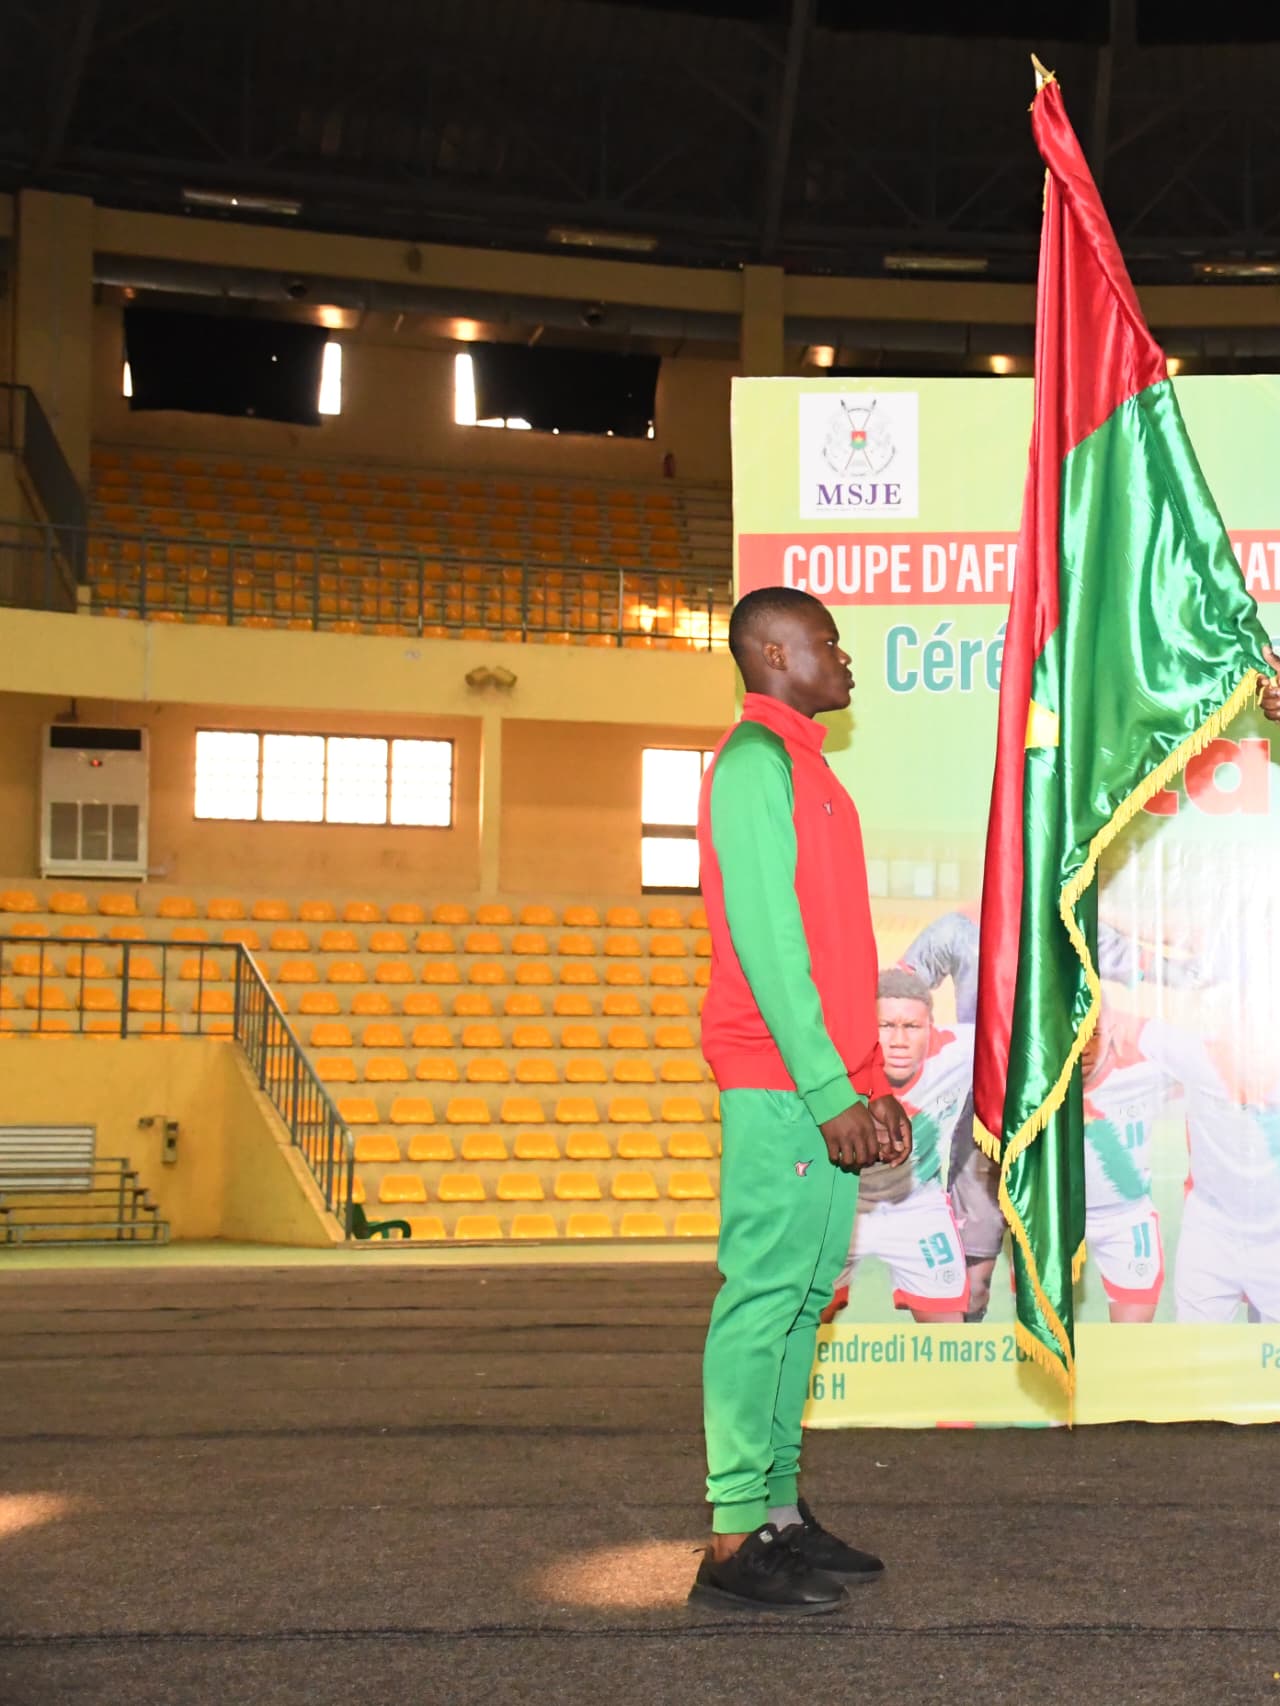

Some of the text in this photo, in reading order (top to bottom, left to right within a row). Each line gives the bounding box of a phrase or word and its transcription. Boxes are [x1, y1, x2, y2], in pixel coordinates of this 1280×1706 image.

[816, 483, 902, 506] MSJE
[784, 544, 911, 594] COUPE
[817, 1334, 905, 1364] endredi
[911, 1335, 933, 1362] 14
[939, 1340, 997, 1363] mars
[831, 1373, 846, 1401] H
